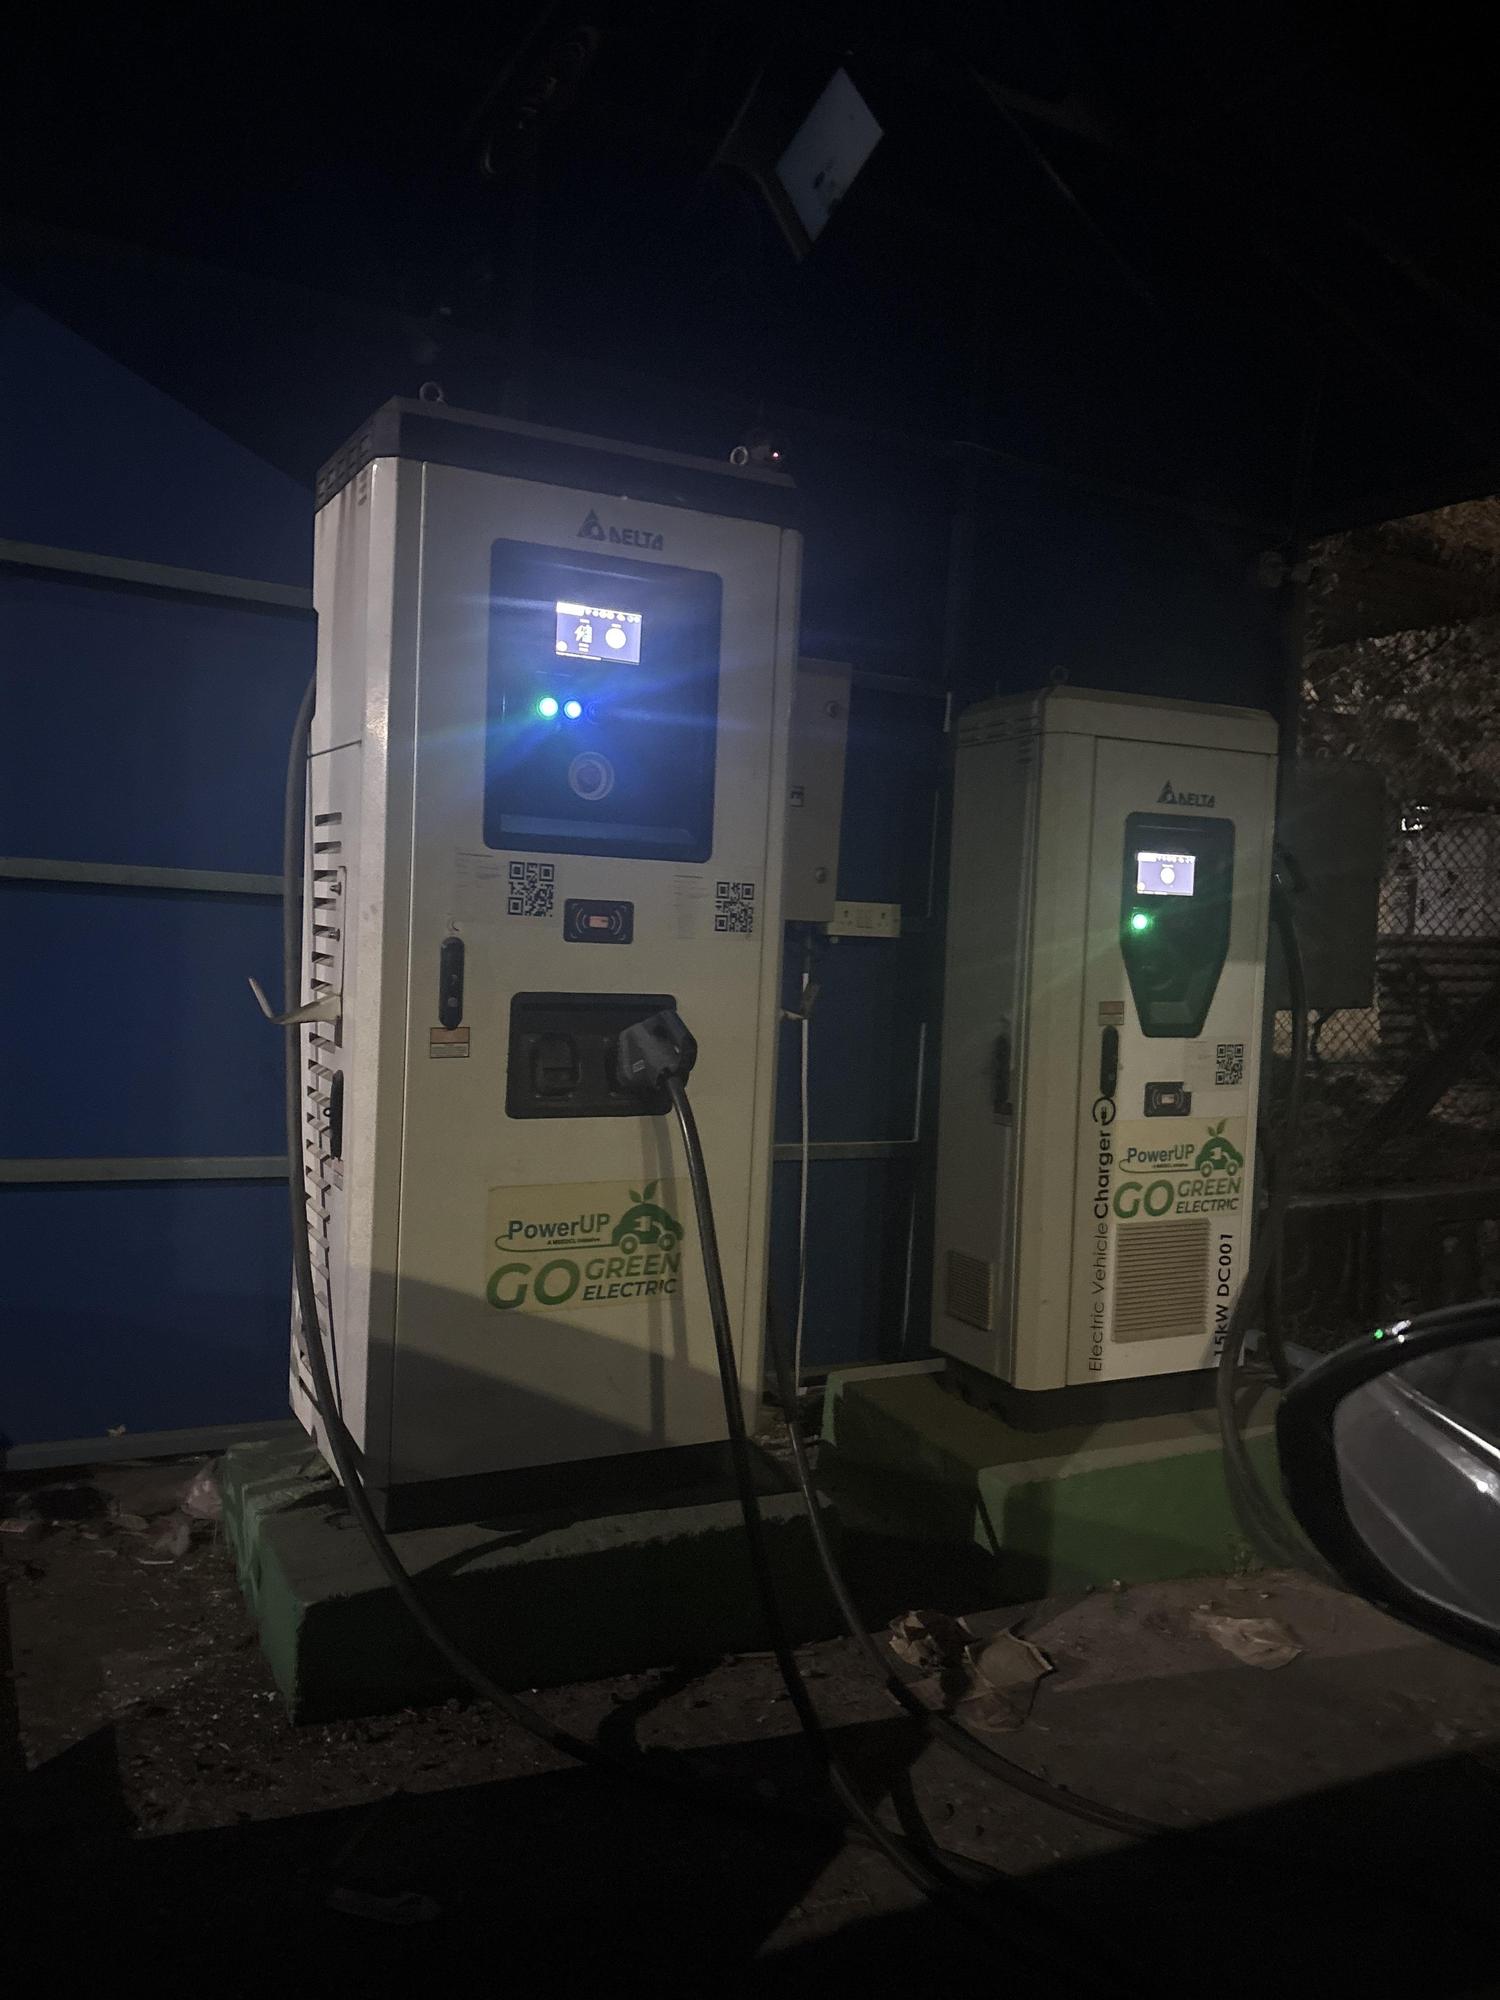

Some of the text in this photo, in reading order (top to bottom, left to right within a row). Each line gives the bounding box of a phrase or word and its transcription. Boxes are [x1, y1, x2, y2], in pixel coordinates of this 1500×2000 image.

[609, 526, 663, 551] DELTA
[1178, 792, 1216, 808] DELTA
[1127, 1144, 1195, 1163] PowerUP
[1113, 1179, 1174, 1219] GO
[1177, 1177, 1241, 1197] GREEN
[1176, 1198, 1239, 1214] ELECTRIC
[508, 1213, 610, 1240] PowerUP
[1088, 1131, 1113, 1371] Electric Vehicle Charger
[586, 1253, 681, 1280] GREEN
[1216, 1233, 1233, 1297] DC001
[486, 1258, 581, 1310] GO
[582, 1278, 677, 1301] ELECTRIC
